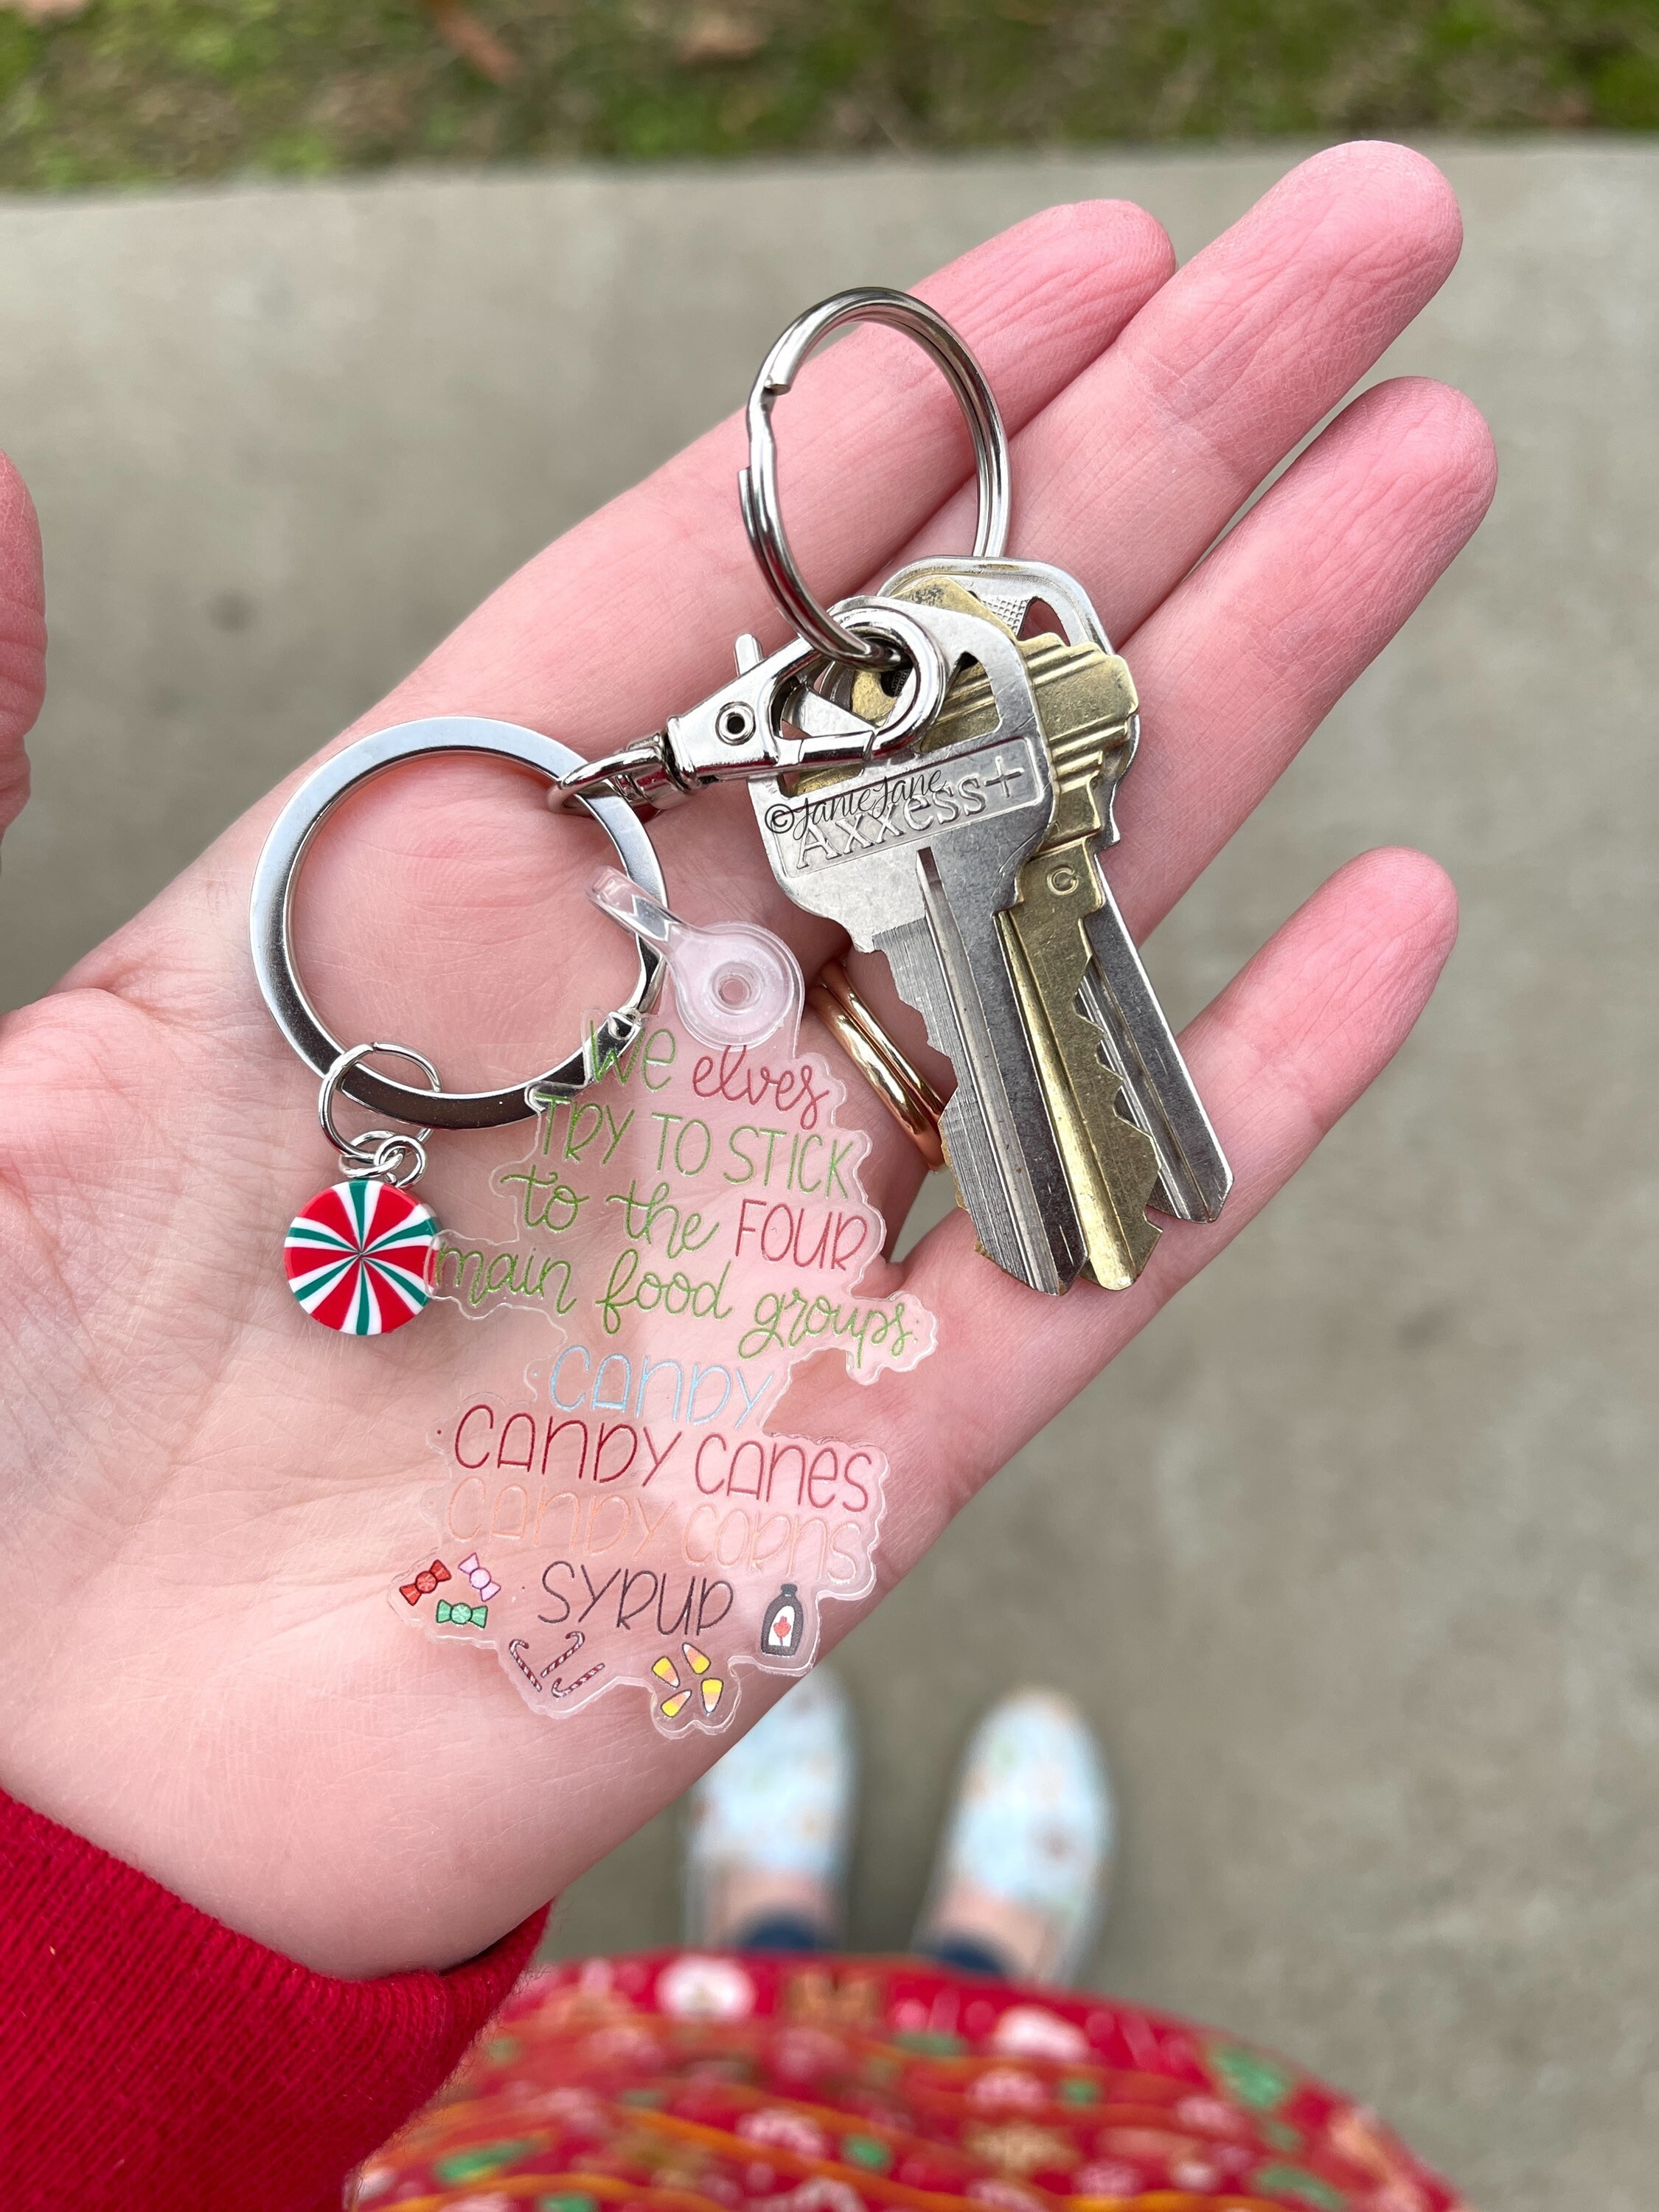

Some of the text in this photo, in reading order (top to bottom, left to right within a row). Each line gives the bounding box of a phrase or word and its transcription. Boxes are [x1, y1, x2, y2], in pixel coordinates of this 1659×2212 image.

[692, 1044, 830, 1130] elves
[533, 1093, 854, 1200] TRY TO STICK
[500, 1164, 869, 1271] to the FOUR
[435, 1242, 577, 1316] main
[595, 1248, 734, 1335] food
[538, 1560, 734, 1636] SYRUP
